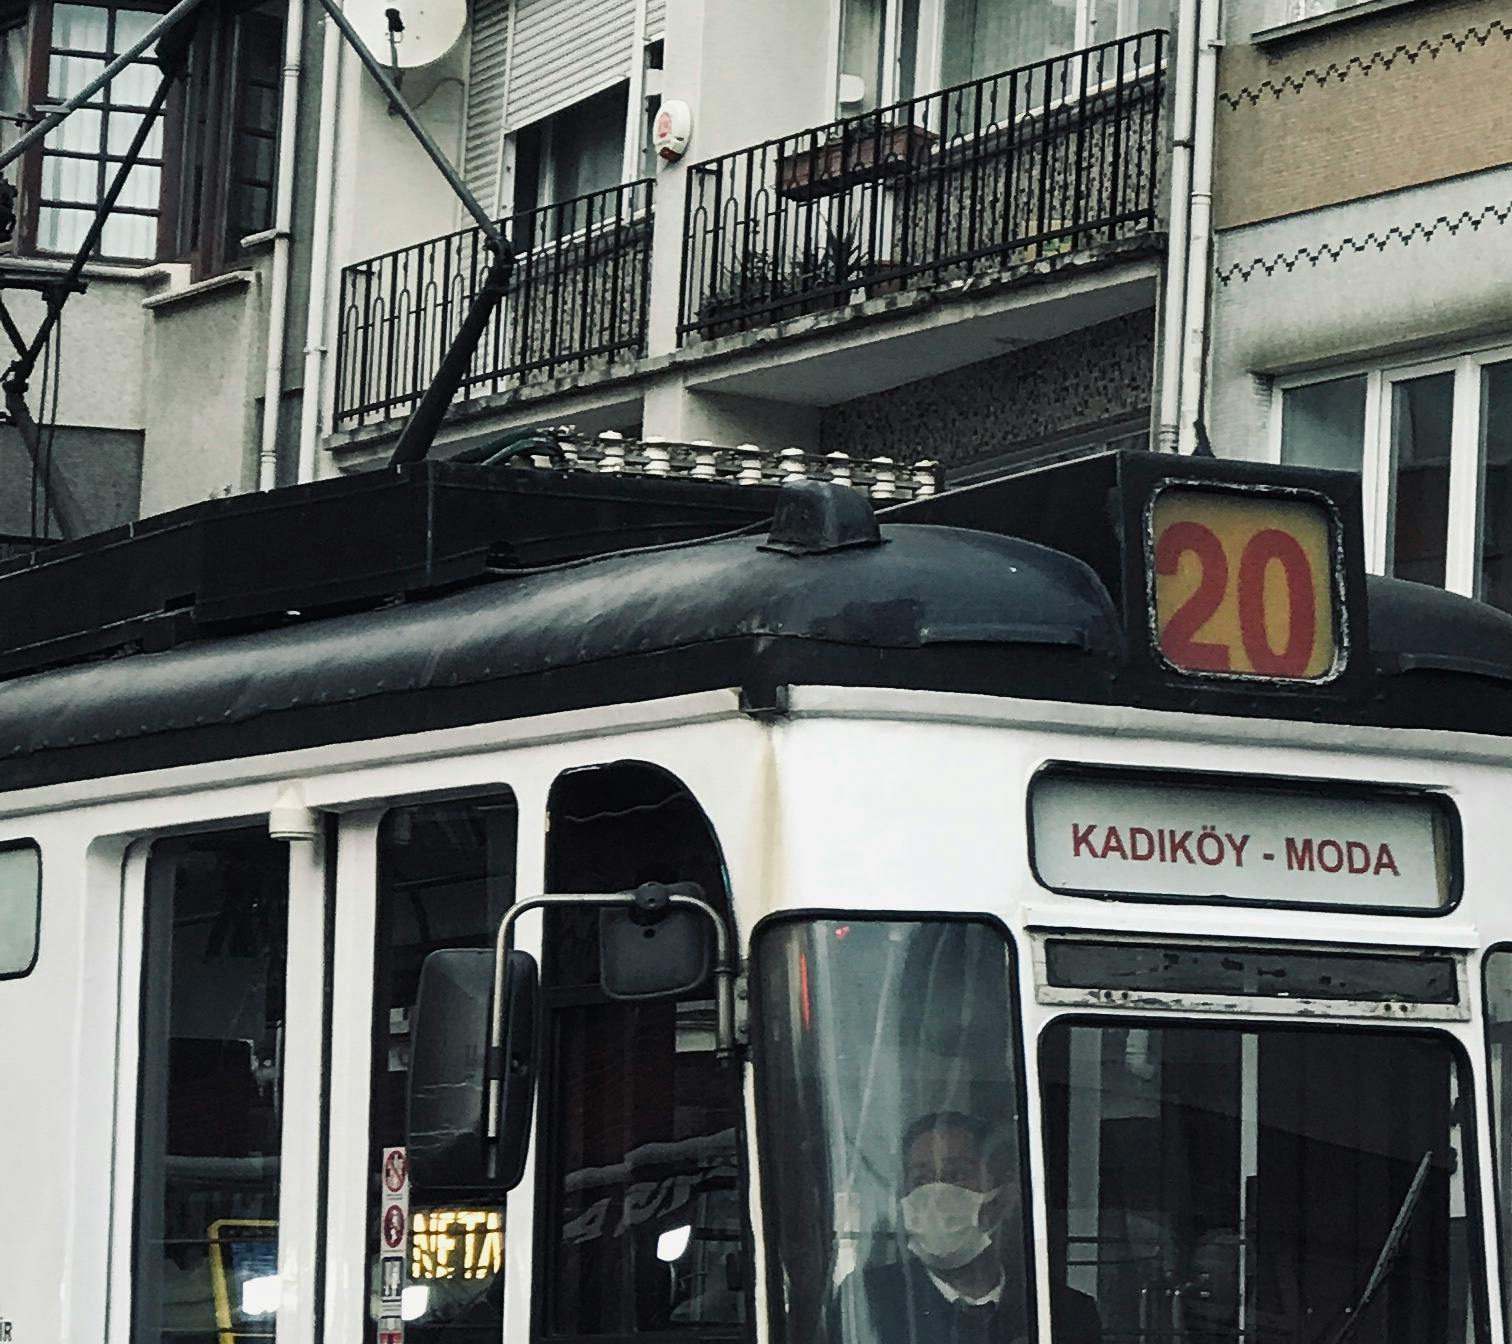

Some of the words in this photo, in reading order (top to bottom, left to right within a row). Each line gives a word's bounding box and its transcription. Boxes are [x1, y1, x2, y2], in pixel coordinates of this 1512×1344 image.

[1157, 521, 1317, 679] 20
[1071, 823, 1249, 869] KADIKÖY
[1286, 838, 1400, 877] MODA
